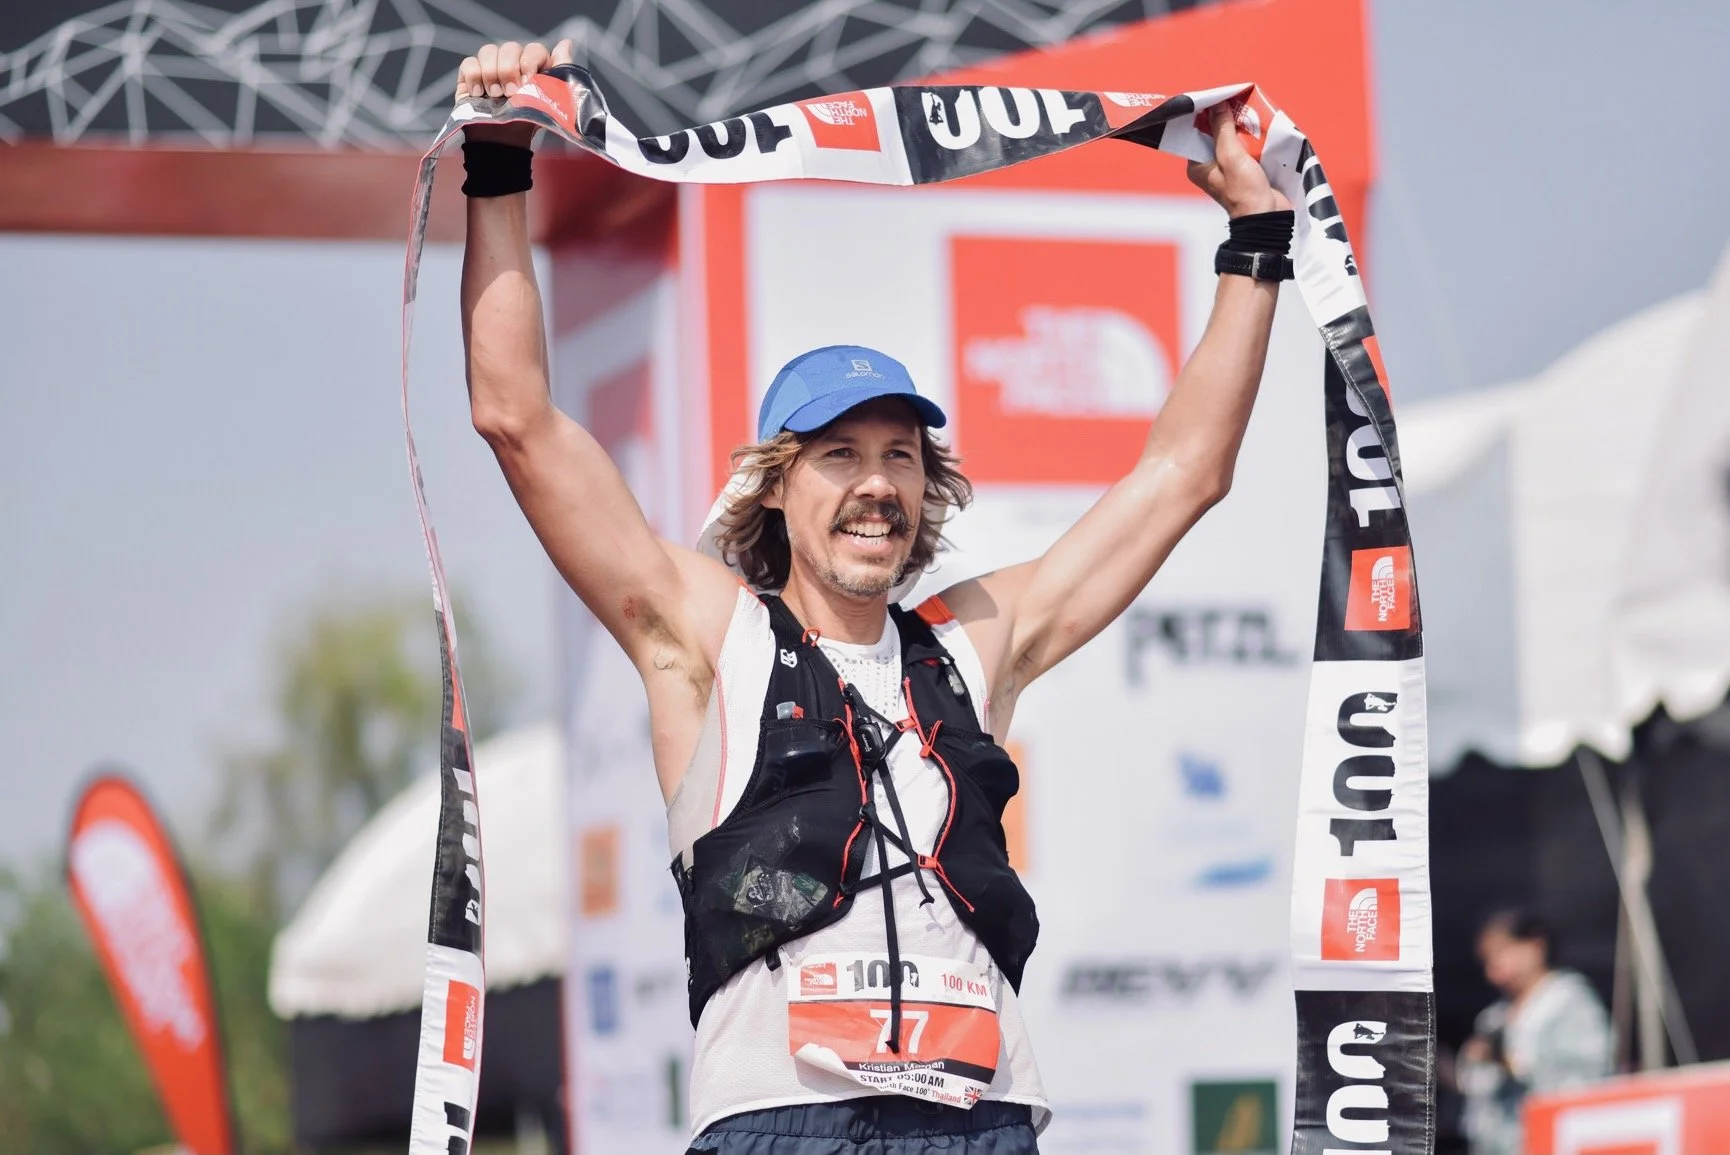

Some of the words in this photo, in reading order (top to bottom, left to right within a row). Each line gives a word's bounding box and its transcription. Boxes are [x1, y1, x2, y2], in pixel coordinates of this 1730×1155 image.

[826, 101, 855, 110] FACE
[831, 107, 868, 117] NORTH
[833, 116, 856, 125] THE
[1371, 579, 1380, 604] THE
[1378, 579, 1388, 622] NORTH
[1387, 578, 1396, 611] FACE
[1329, 692, 1398, 857] 100
[1346, 909, 1359, 933] THE
[1355, 909, 1368, 953] NORTH
[1366, 909, 1378, 941] FACE
[846, 959, 920, 992] 100
[941, 972, 963, 991] 100
[966, 982, 988, 997] KM
[869, 1008, 929, 1054] 77
[859, 1063, 901, 1073] Kristian
[898, 1083, 914, 1093] Face
[932, 1091, 962, 1104] Thailand
[928, 1076, 945, 1089] AM
[1323, 1020, 1392, 1155] 00
